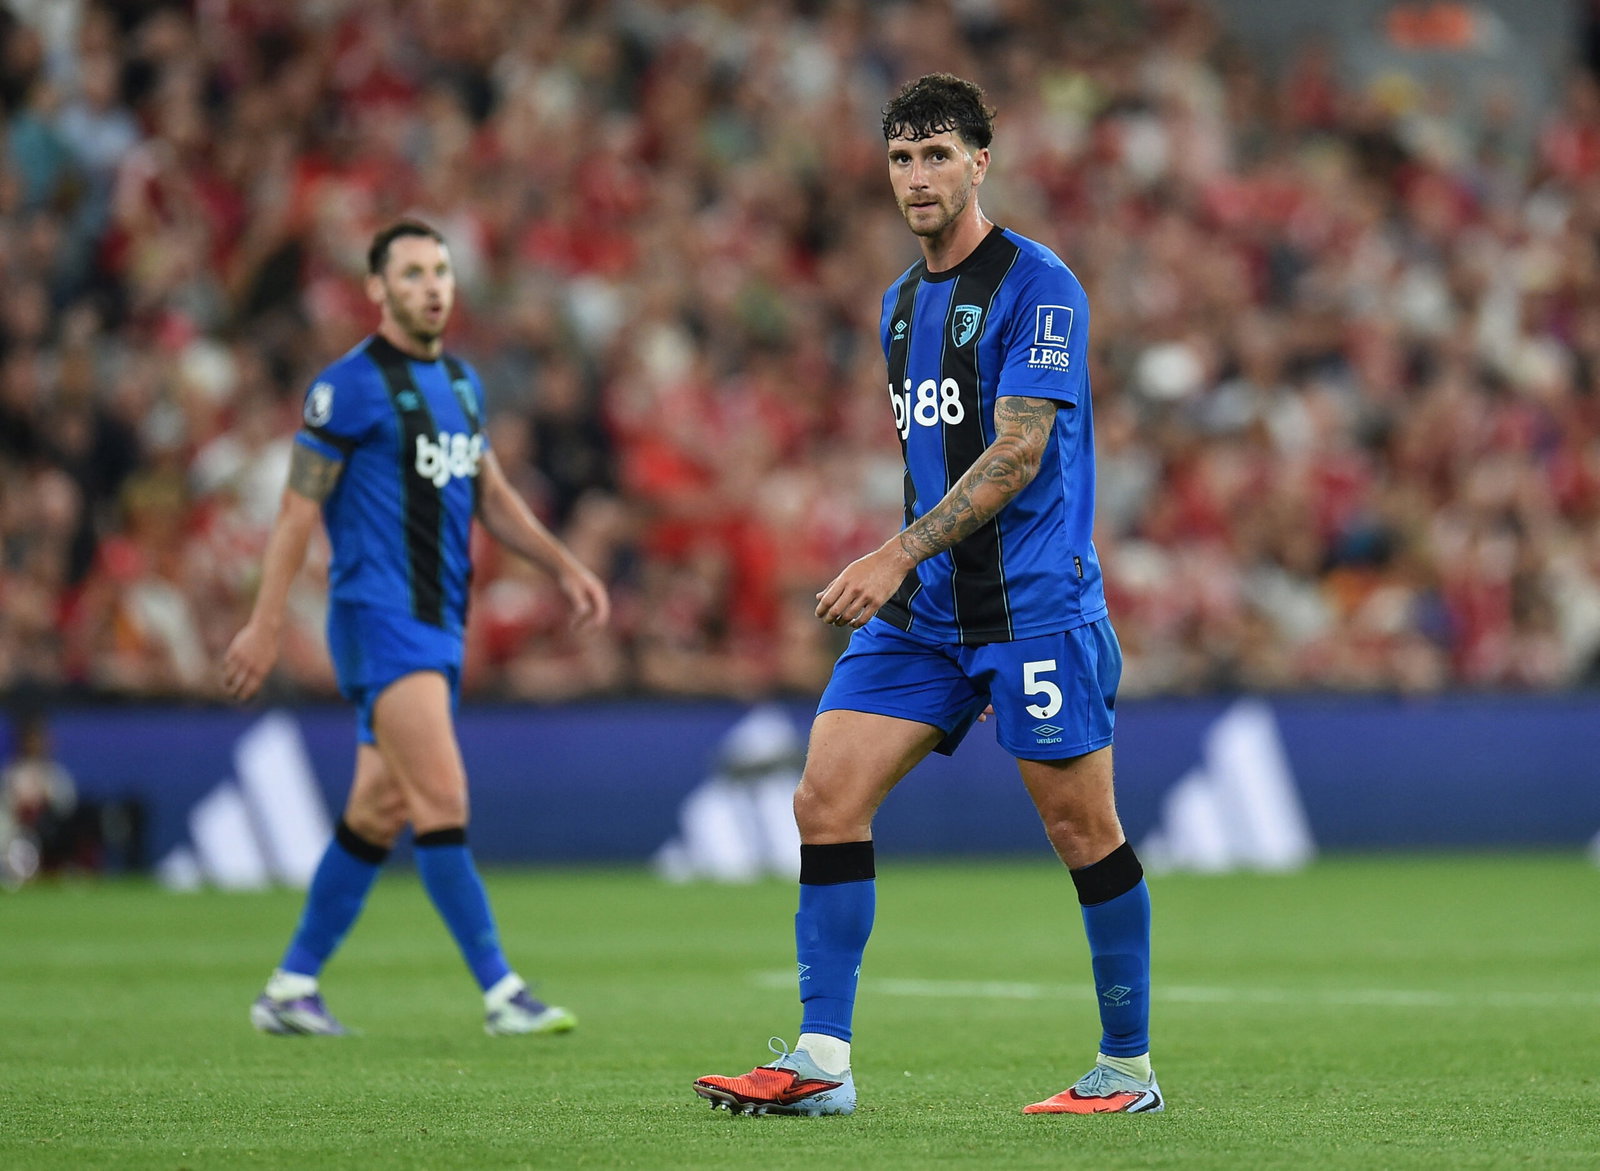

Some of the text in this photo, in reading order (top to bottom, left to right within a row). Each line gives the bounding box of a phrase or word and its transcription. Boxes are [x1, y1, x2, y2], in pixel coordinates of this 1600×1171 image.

[1028, 348, 1070, 367] LEOS
[888, 378, 965, 440] bj88
[1023, 659, 1063, 720] 5
